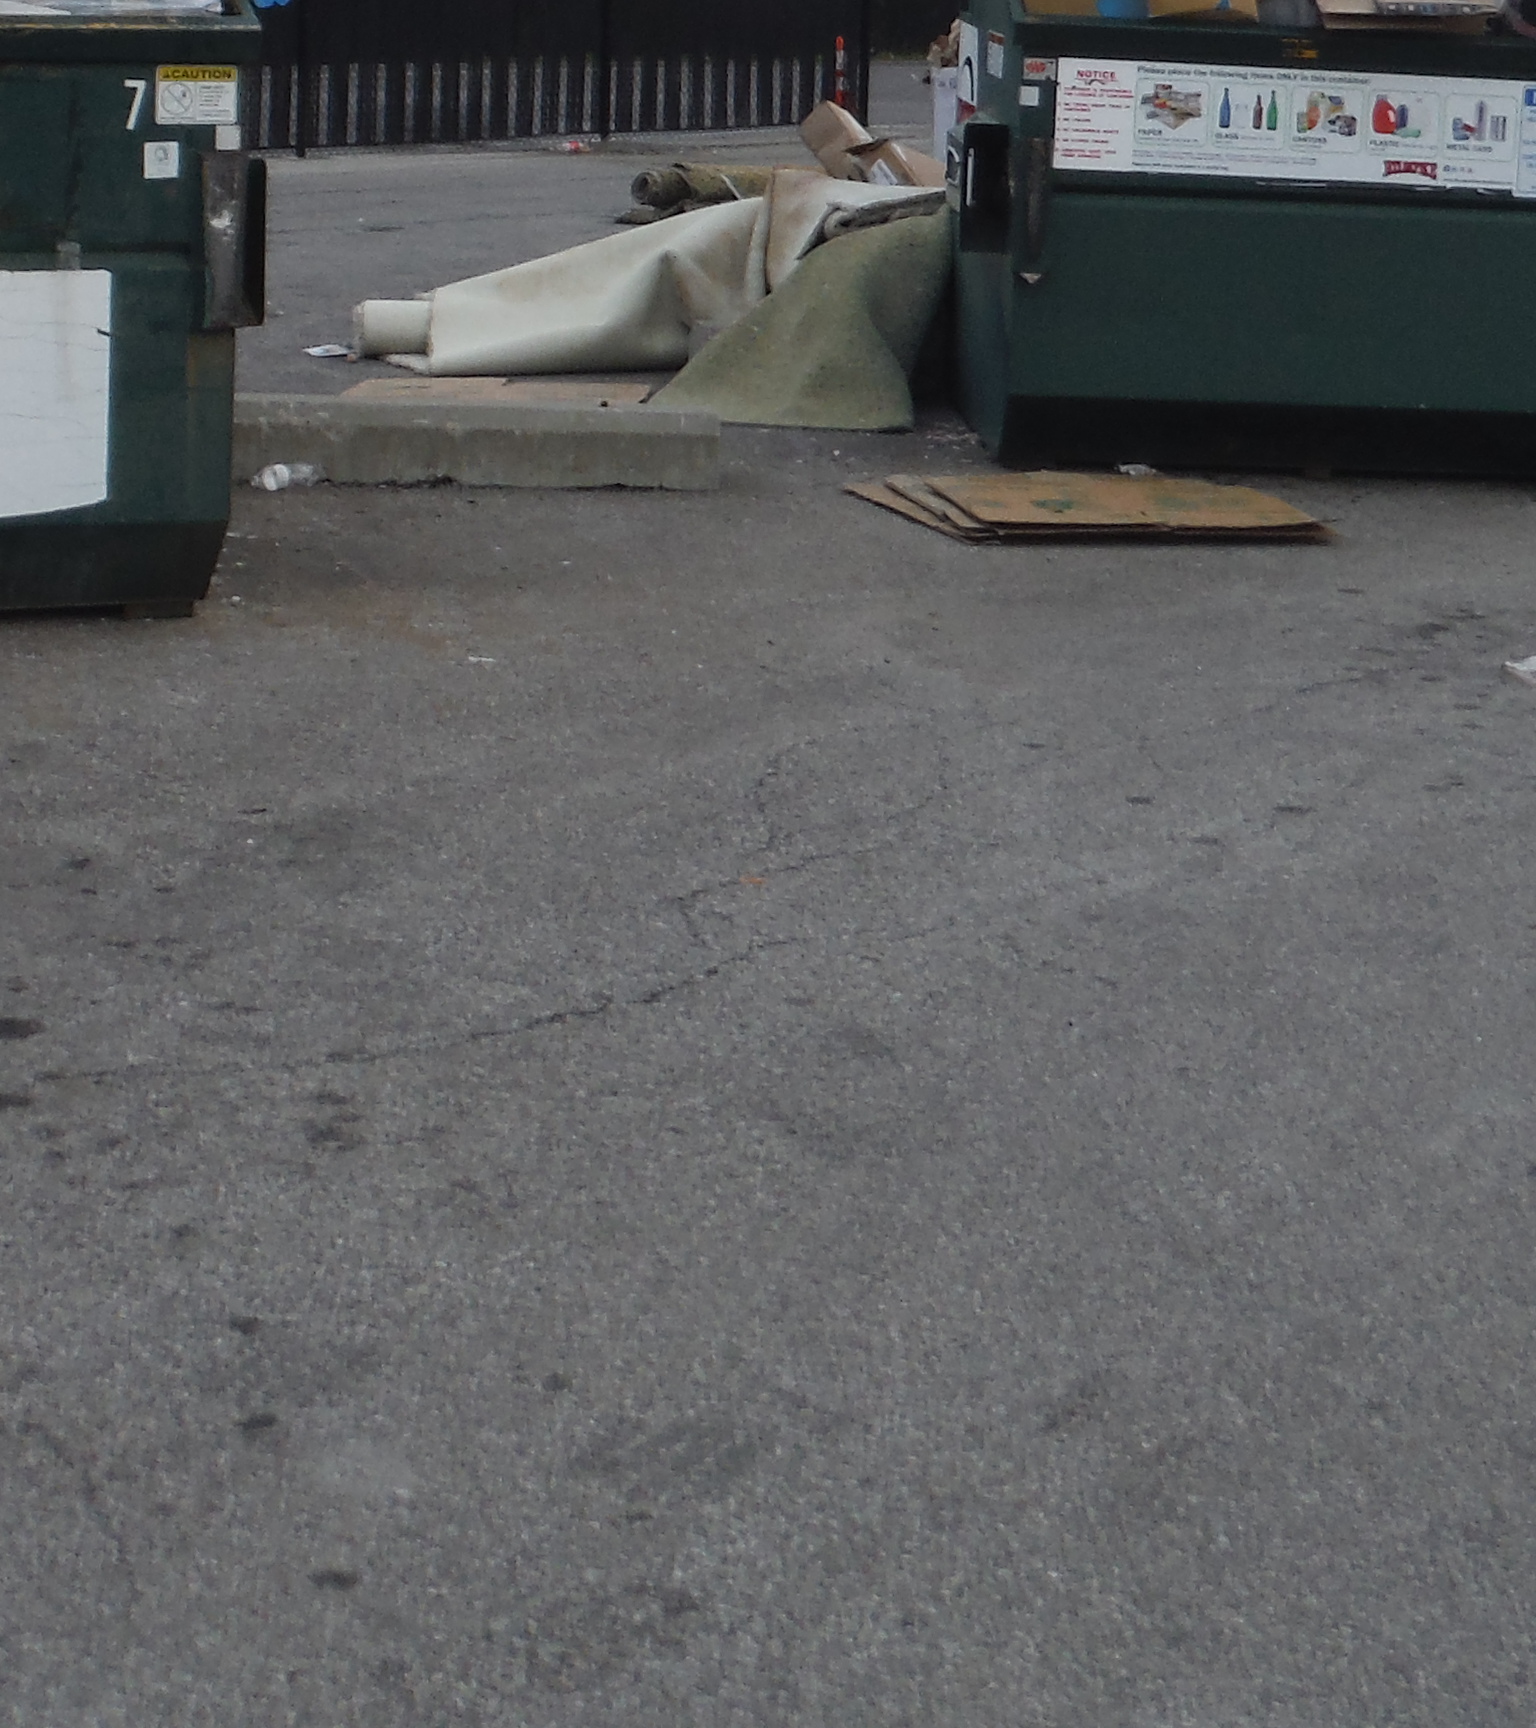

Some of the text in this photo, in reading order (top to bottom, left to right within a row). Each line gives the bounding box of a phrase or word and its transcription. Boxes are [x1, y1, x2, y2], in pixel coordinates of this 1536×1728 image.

[171, 69, 232, 79] CAUTION
[1076, 69, 1117, 79] NOTICE
[124, 78, 147, 131] 7
